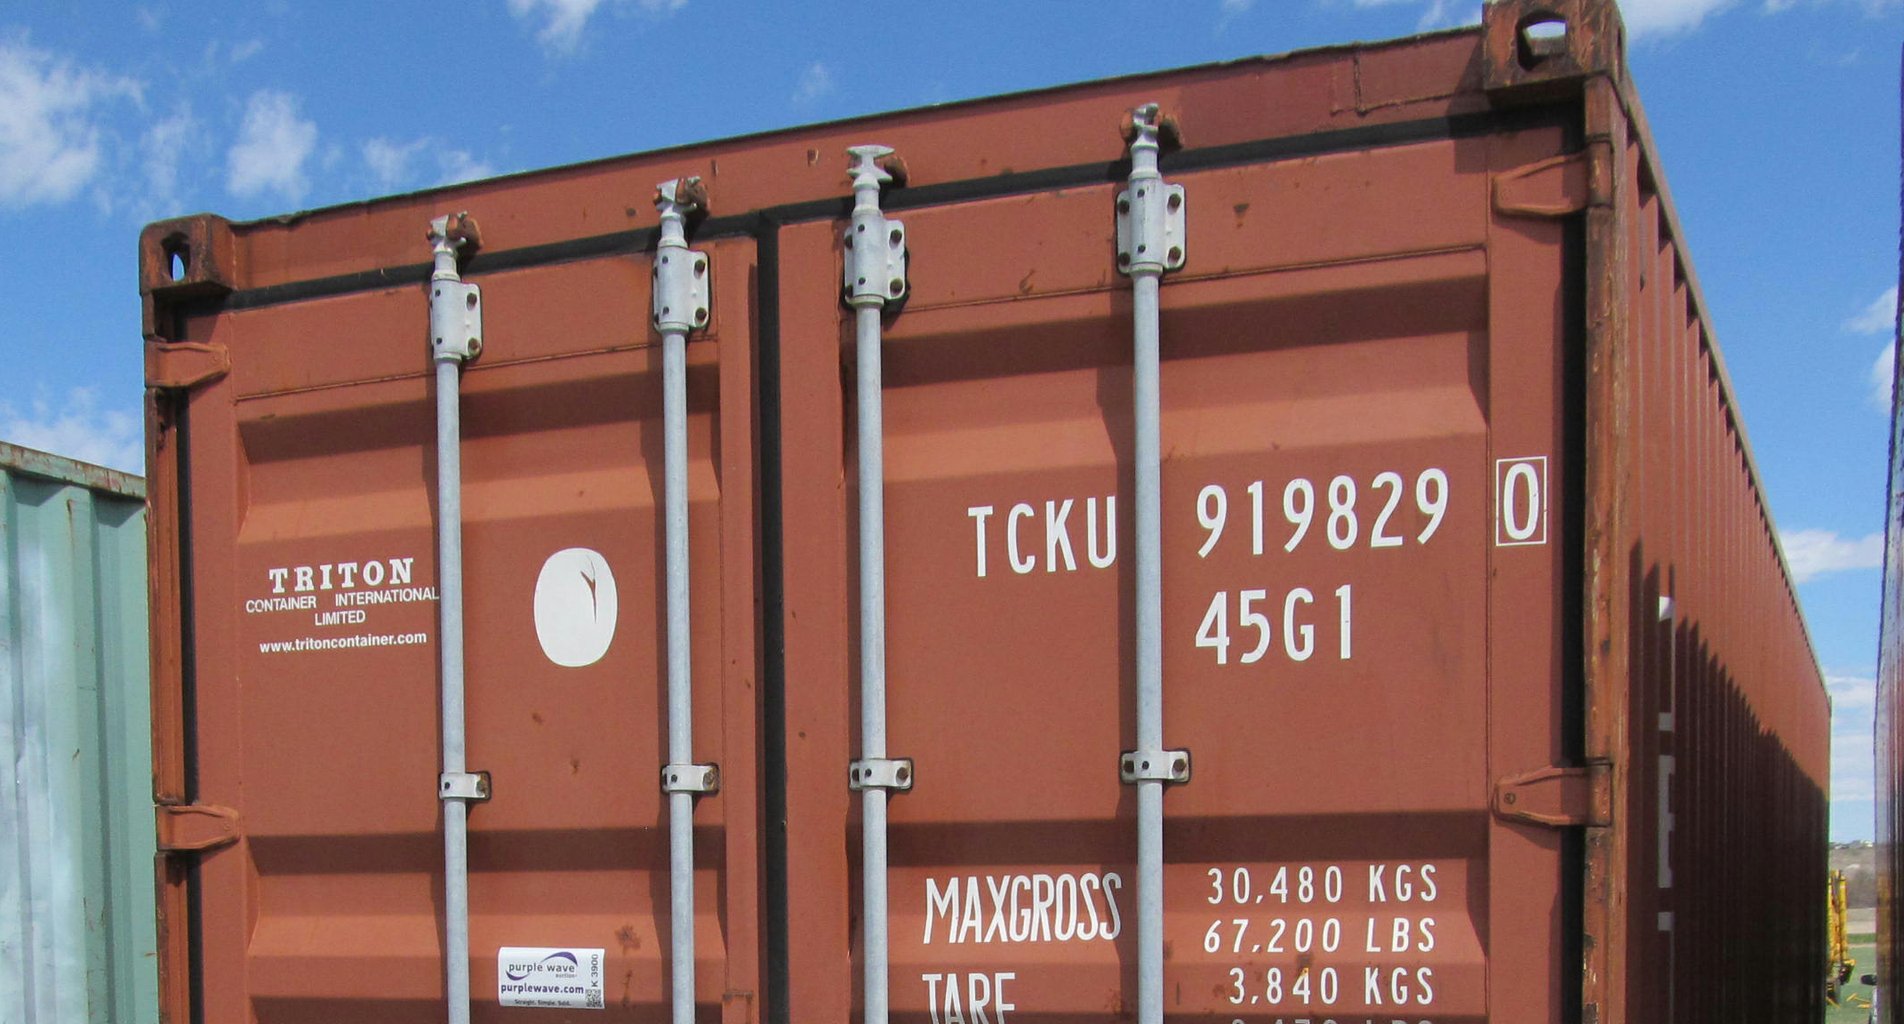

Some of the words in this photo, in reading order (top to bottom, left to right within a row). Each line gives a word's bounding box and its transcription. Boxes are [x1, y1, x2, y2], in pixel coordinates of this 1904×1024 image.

[968, 495, 1117, 577] TCKU
[1196, 468, 1449, 558] 919829
[1502, 461, 1541, 541] 0
[269, 557, 414, 593] TRITON
[246, 595, 317, 613] CONTAINER
[335, 586, 439, 607] INTERNATIONAL
[314, 610, 366, 626] LIMITED
[1195, 584, 1352, 664] 45G1
[259, 632, 427, 653] www.tritoncontainer.com
[923, 872, 1122, 944] MAXGROSS
[1207, 866, 1342, 904] 30,480
[1369, 864, 1437, 902] KGS
[1204, 918, 1341, 953] 67,200
[1366, 917, 1435, 952] LBS
[508, 963, 543, 975] purple
[546, 964, 575, 973] wave
[1229, 967, 1338, 1005] 3,840
[1365, 966, 1433, 1005] KGS
[501, 982, 584, 994] purplewave.com
